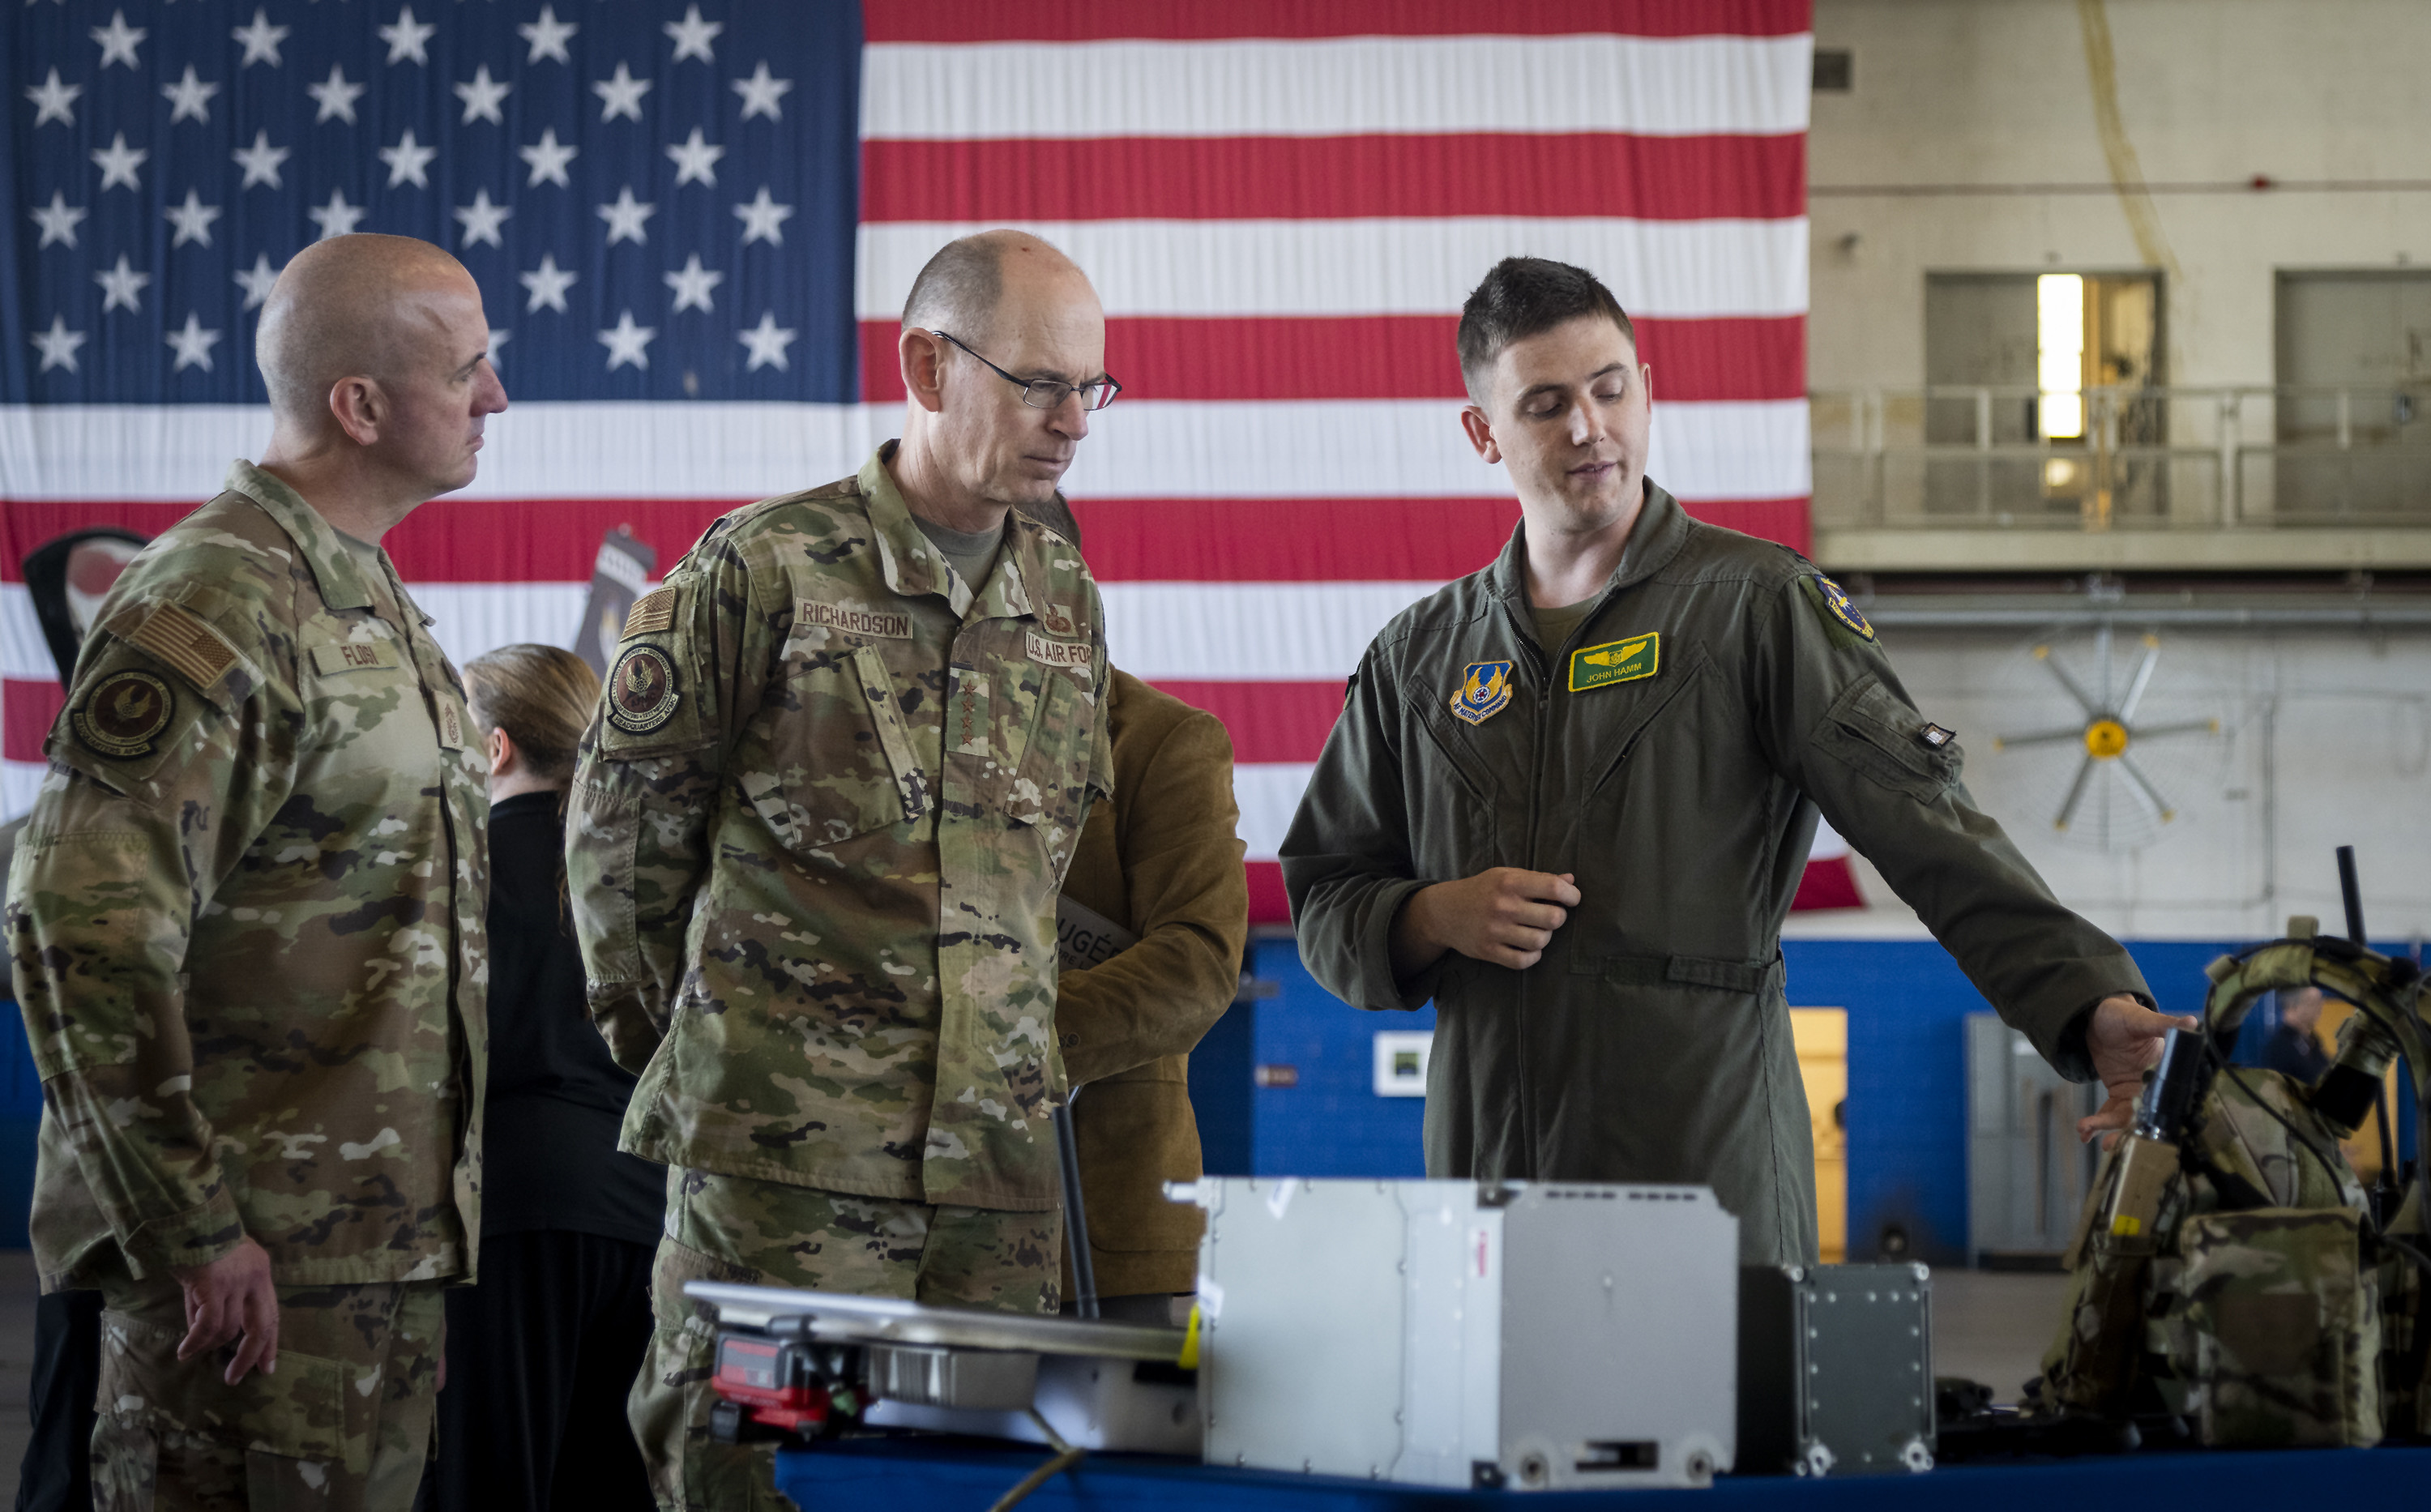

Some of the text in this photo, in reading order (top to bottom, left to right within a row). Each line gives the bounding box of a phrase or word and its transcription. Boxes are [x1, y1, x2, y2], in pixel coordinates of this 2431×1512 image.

[802, 602, 908, 636] RICHARDSON
[340, 644, 378, 665] FLOSI
[1028, 634, 1044, 659] U.S.
[1045, 642, 1067, 662] AIR
[1587, 662, 1642, 683] JOHN HAMM
[616, 697, 677, 730] HEADQUARTERS AFMC
[1453, 703, 1461, 711] AF
[1481, 694, 1507, 717] COMMAND
